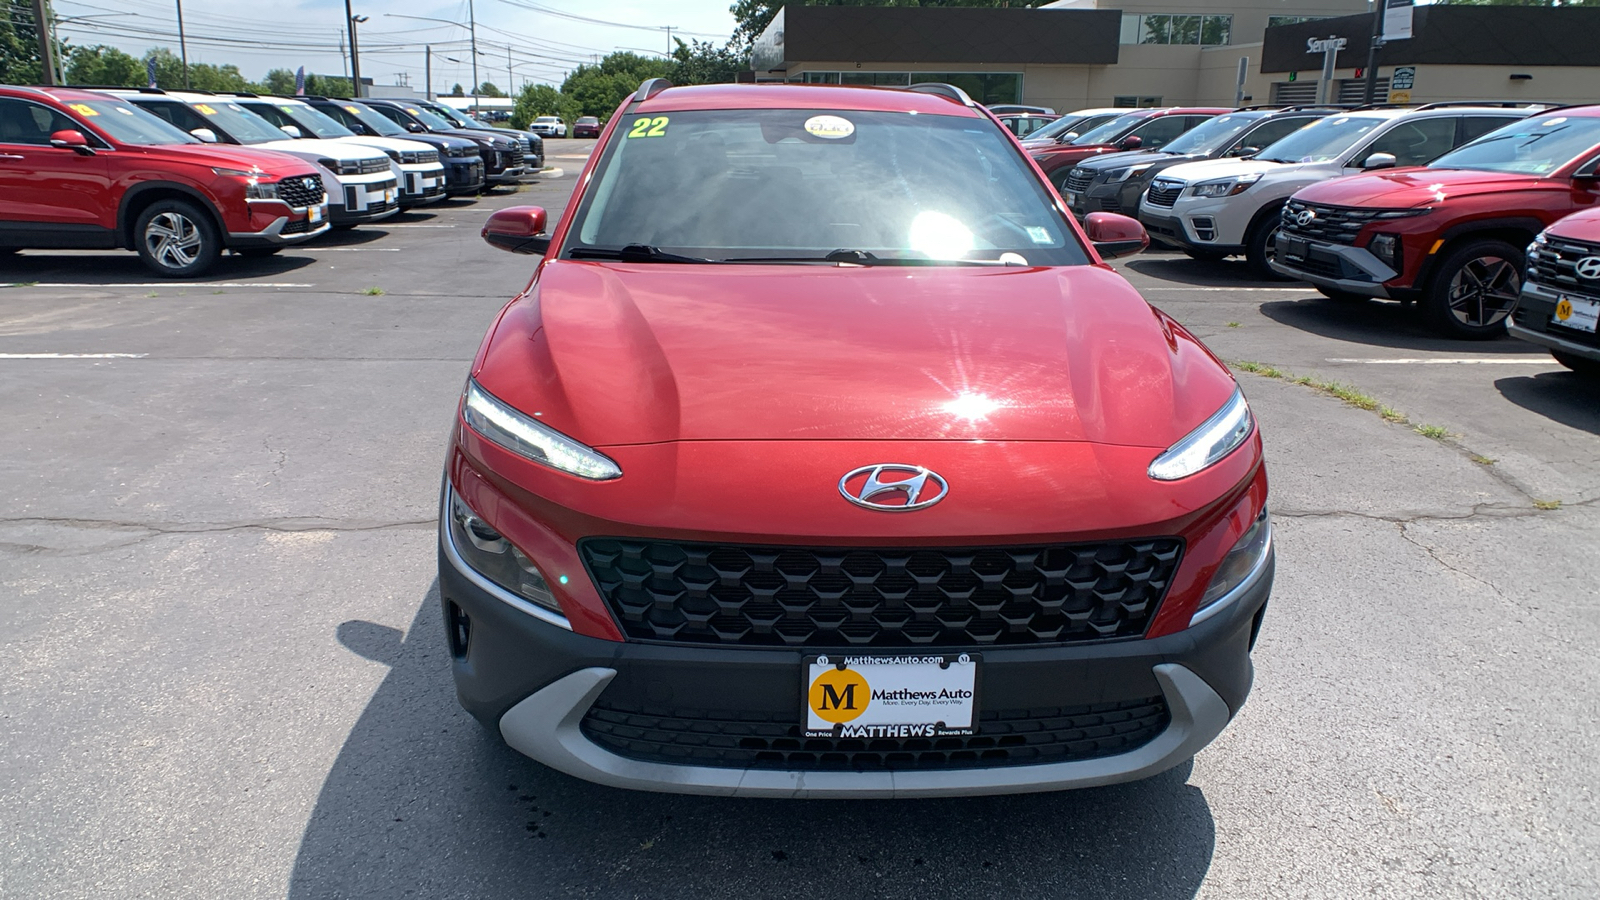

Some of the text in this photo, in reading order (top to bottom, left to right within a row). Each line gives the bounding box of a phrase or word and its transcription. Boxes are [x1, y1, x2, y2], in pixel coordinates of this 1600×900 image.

[1305, 34, 1347, 54] Service
[628, 116, 669, 139] 22
[1559, 305, 1571, 316] M
[844, 655, 944, 665] MatthewsAuto.com
[817, 683, 858, 711] M
[871, 688, 972, 700] Matthews Auto
[840, 724, 935, 738] MATTHEWS
